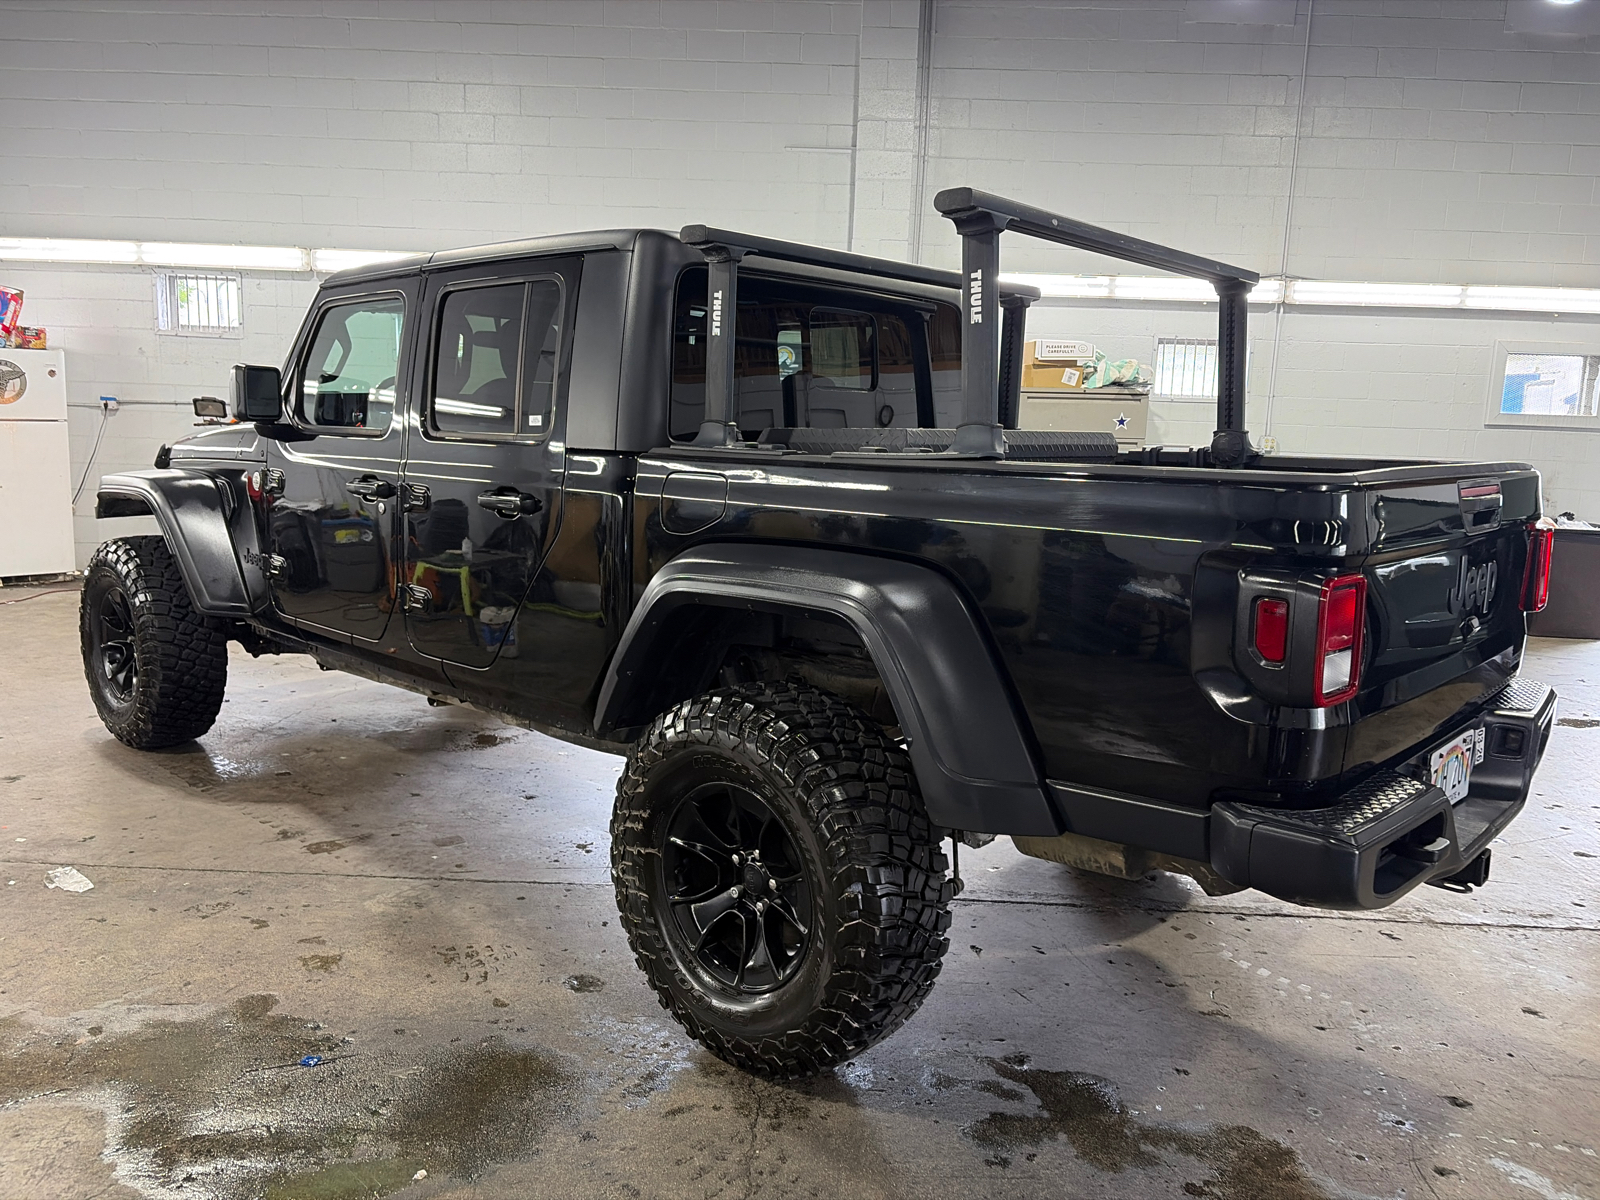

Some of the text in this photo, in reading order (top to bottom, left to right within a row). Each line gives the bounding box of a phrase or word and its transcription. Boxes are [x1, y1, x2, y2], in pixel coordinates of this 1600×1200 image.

[711, 290, 723, 336] THULE
[970, 269, 982, 325] THULE
[243, 547, 263, 570] Jeep
[1447, 555, 1498, 614] Jeep
